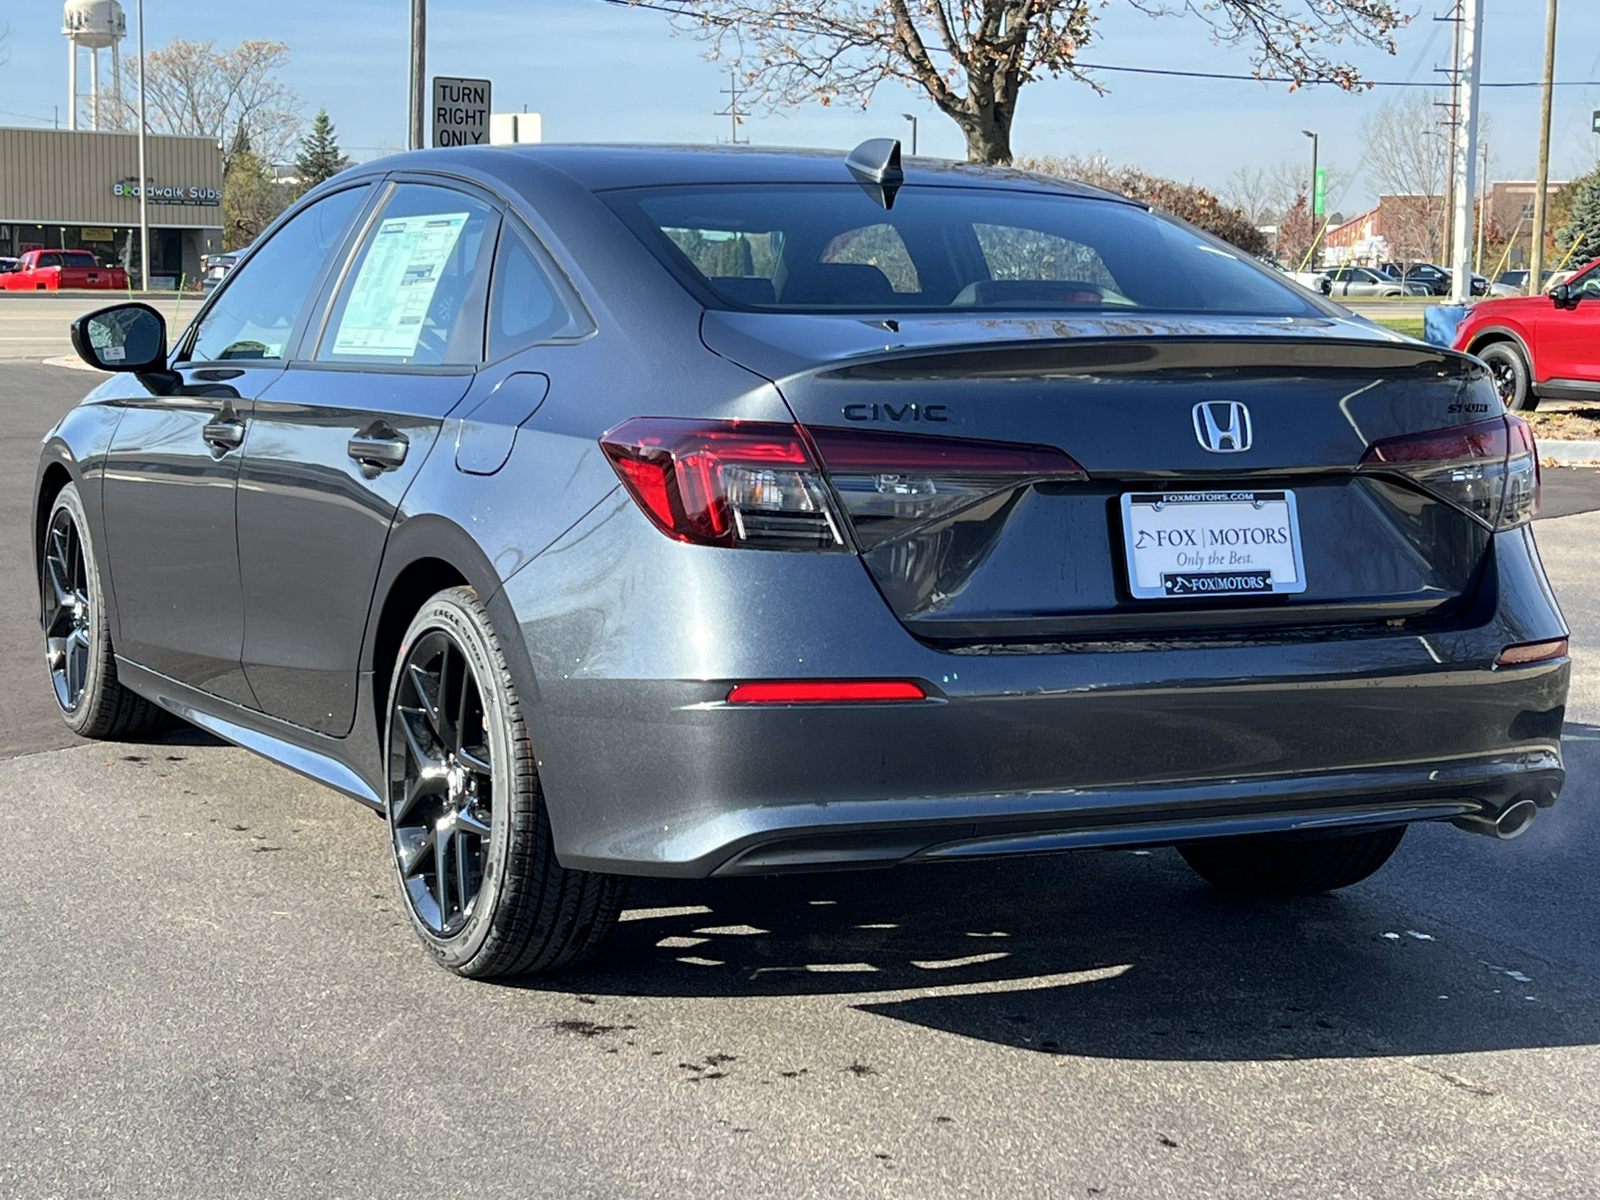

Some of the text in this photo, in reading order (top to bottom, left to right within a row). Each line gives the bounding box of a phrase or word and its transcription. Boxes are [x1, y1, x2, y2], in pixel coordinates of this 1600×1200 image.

[439, 85, 485, 104] TURN
[437, 107, 487, 127] RIGHT
[113, 184, 223, 199] Boadwalk Subs
[841, 403, 948, 421] CIVIC
[1447, 403, 1490, 414] SPORT
[1162, 493, 1255, 502] FOXMOTORS.COM
[1156, 527, 1287, 547] FOX MOTORS
[1176, 551, 1254, 570] Only the Best.
[433, 609, 460, 627] EAGLE
